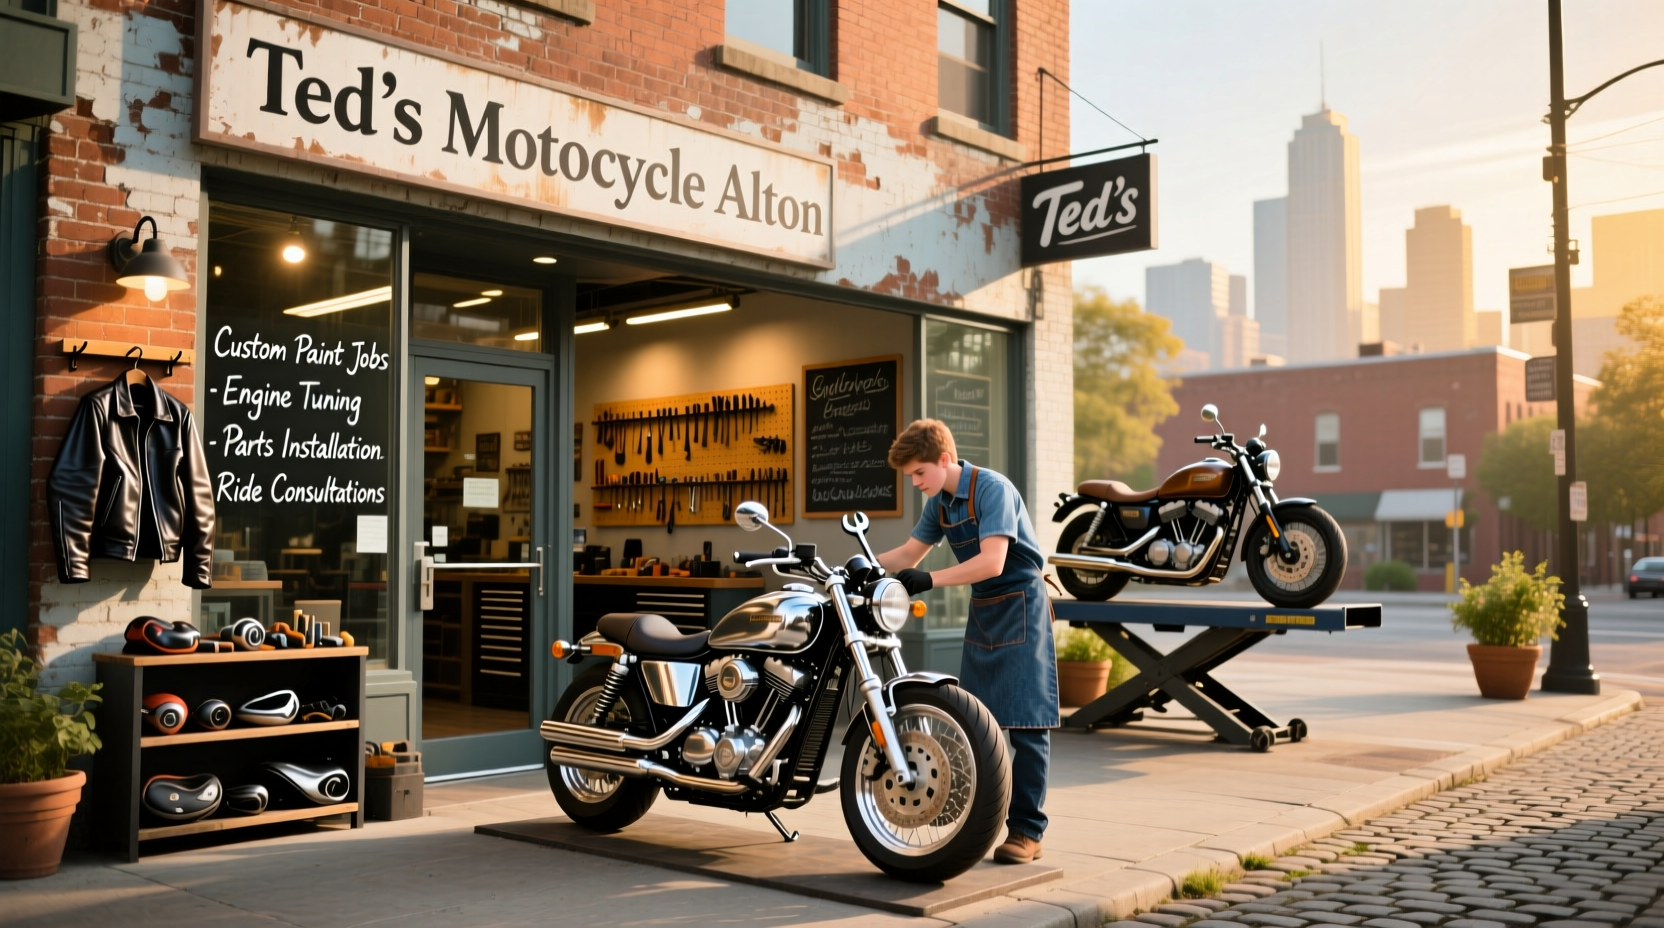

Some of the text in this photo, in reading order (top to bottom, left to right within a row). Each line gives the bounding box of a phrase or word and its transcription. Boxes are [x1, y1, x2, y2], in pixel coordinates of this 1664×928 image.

[246, 37, 824, 236] Ted's Motocycle Alton
[1032, 175, 1138, 247] Ted's
[214, 325, 389, 375] Custom Paint Jobs
[223, 375, 292, 420] Engine
[299, 381, 362, 426] Tuning
[223, 423, 274, 457] Parts
[216, 471, 385, 503] Ride Consultations
